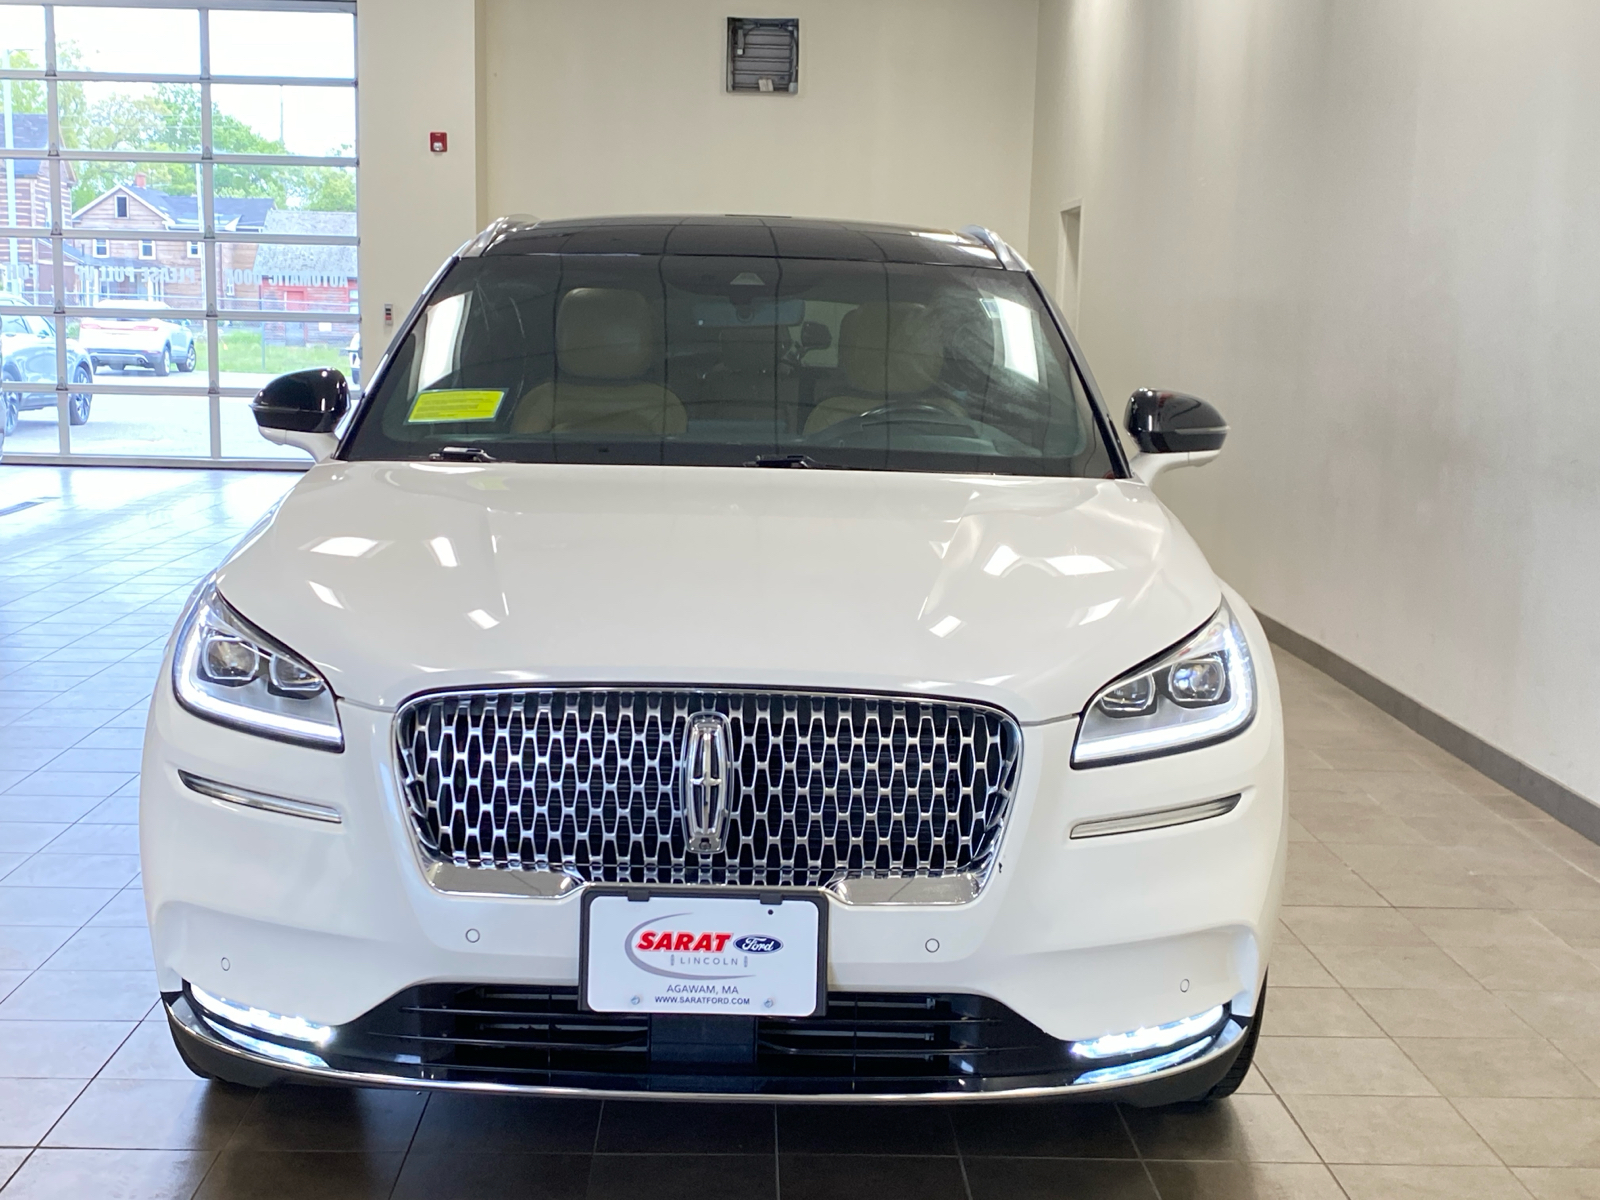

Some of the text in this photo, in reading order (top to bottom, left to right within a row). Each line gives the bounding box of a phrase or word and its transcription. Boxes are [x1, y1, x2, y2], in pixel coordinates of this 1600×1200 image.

[637, 930, 732, 953] SARAT
[742, 937, 774, 952] Ford
[680, 957, 738, 966] LINCOLN
[666, 984, 739, 995] AGAWAM, MA
[654, 996, 750, 1005] WWW.SARATFORD.COM
